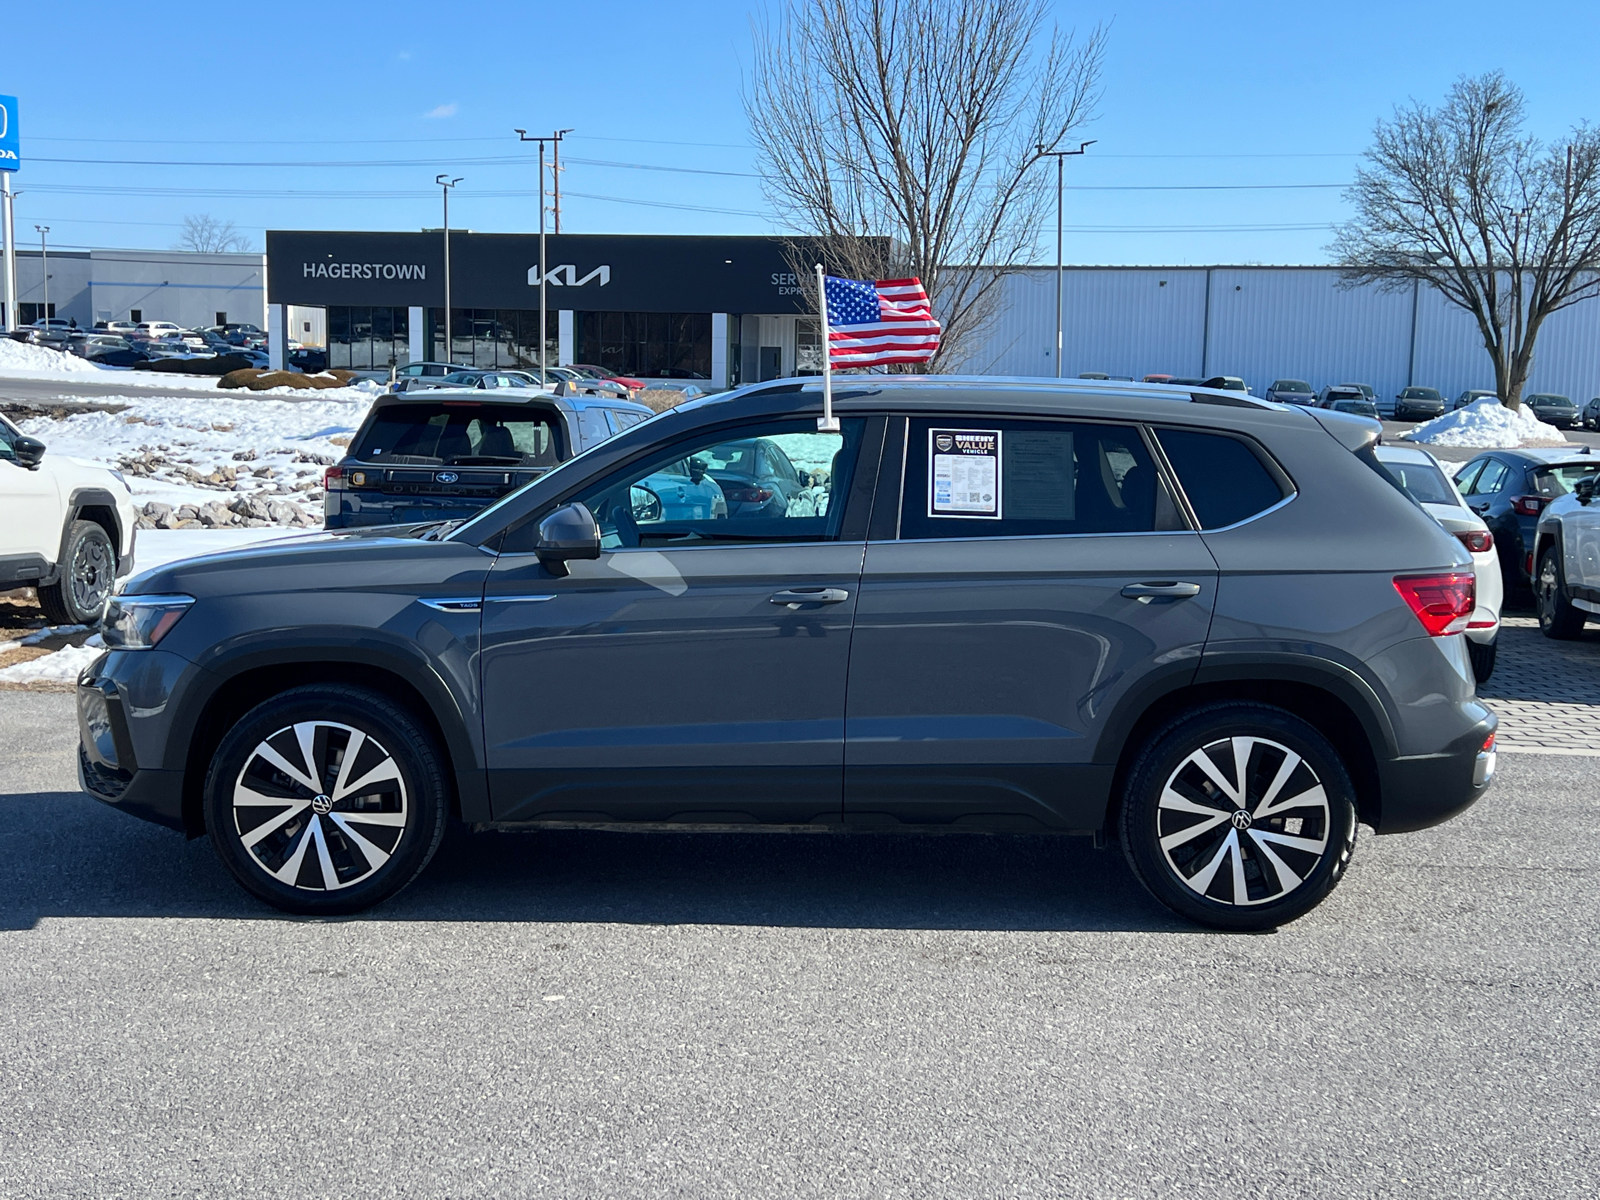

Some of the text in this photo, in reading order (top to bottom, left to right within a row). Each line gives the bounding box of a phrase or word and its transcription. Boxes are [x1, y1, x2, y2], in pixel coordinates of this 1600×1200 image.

[303, 263, 426, 280] HAGERSTOWN
[527, 264, 610, 287] KIA
[955, 441, 995, 450] VALUE
